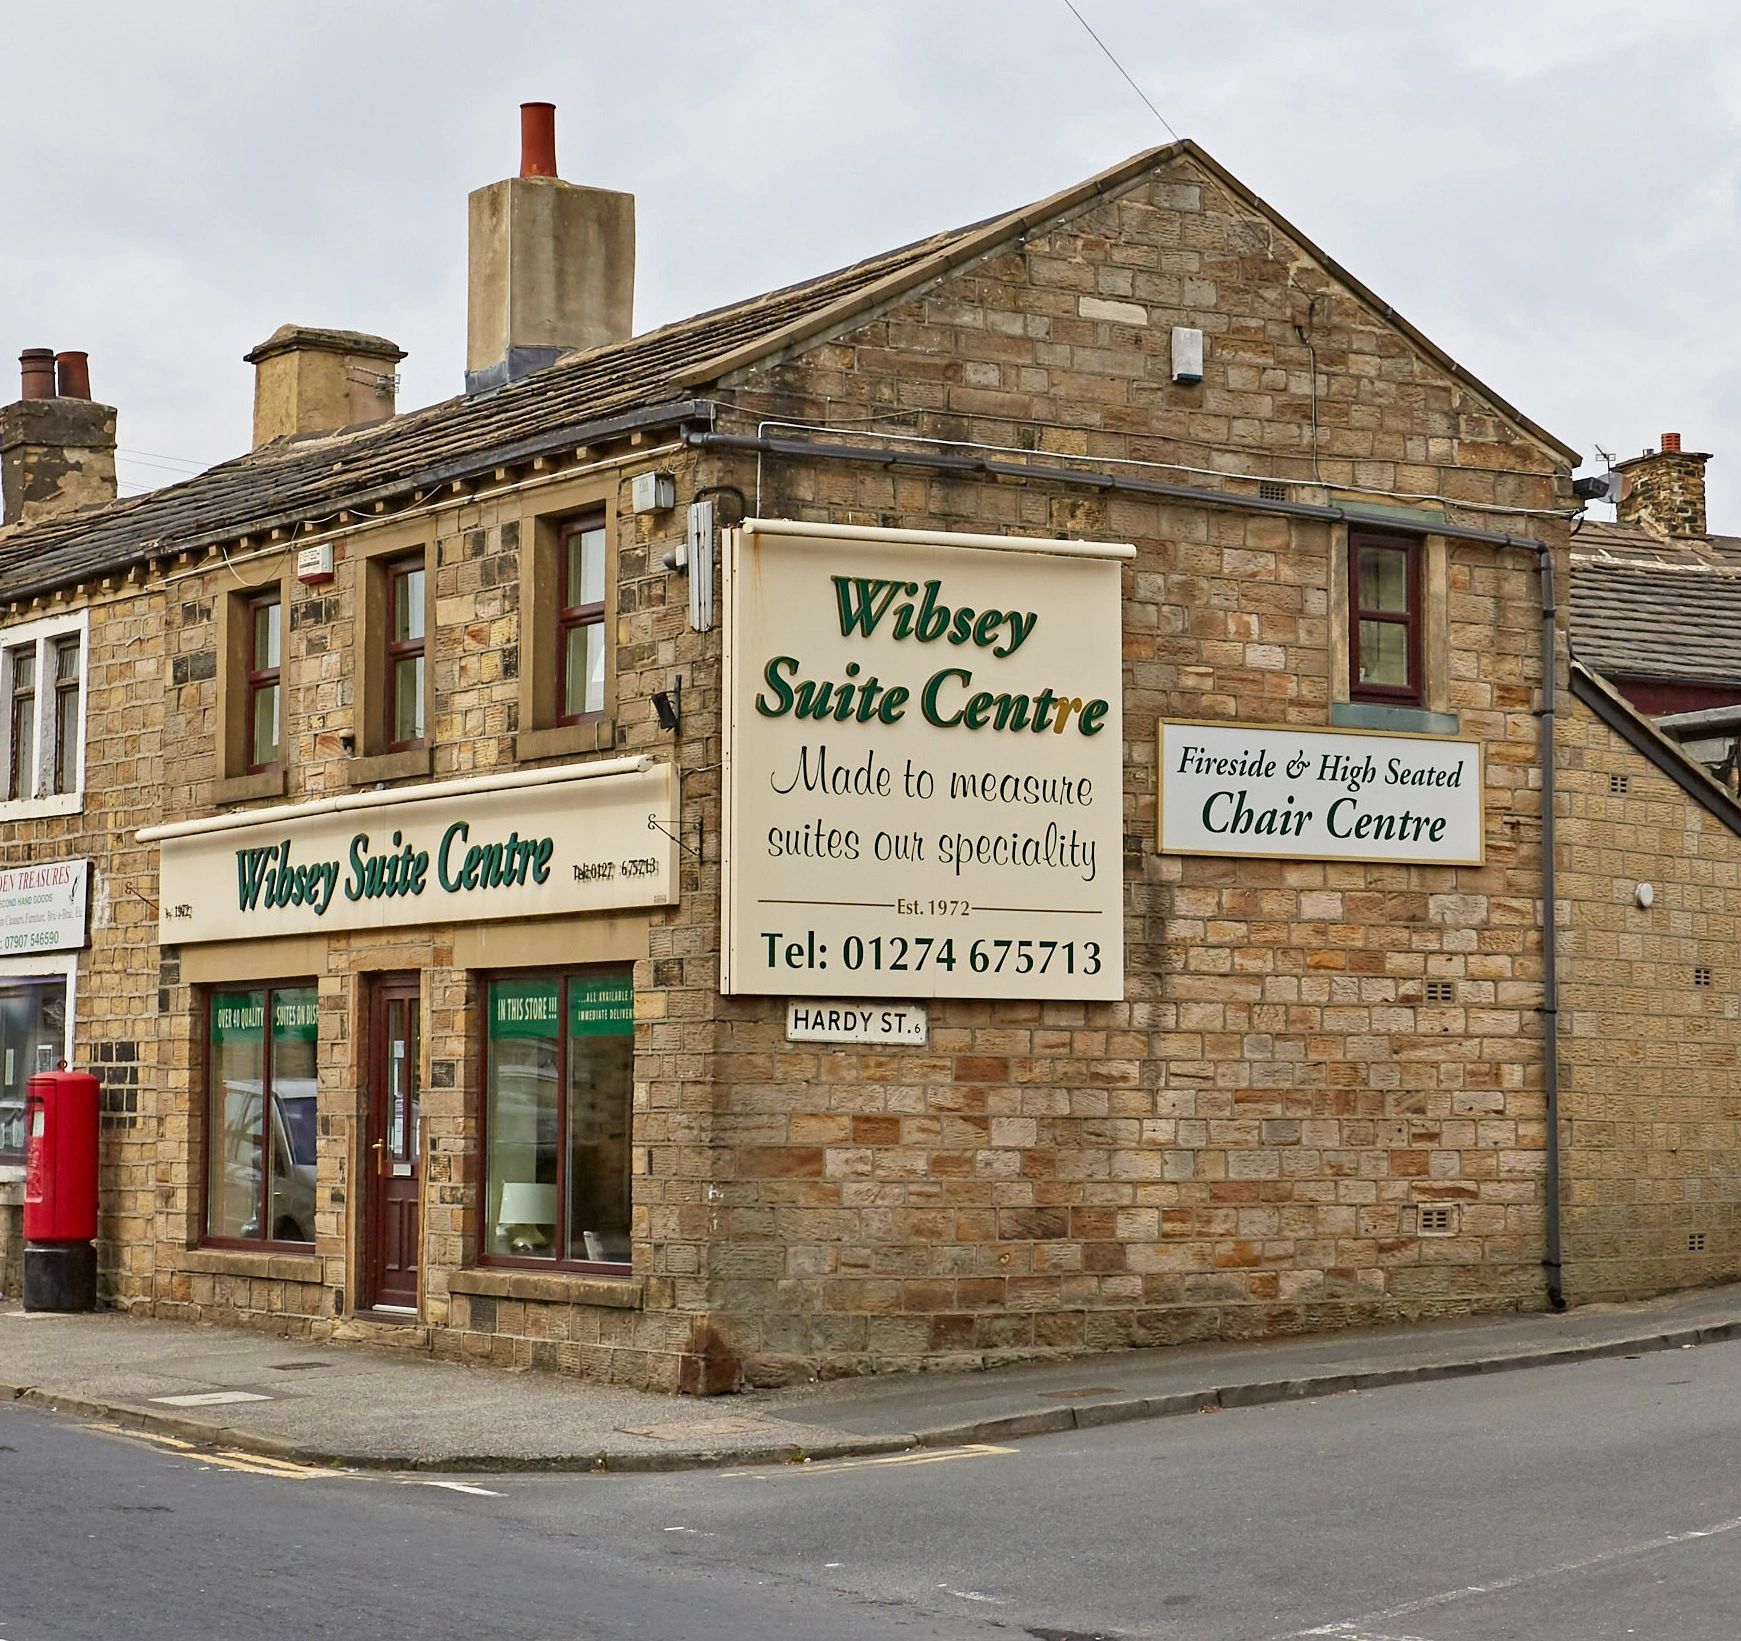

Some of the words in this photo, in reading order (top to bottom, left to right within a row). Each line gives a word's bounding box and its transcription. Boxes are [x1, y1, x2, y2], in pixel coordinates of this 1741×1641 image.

[831, 575, 1037, 658] Wibsey
[755, 655, 909, 724] Suite
[921, 667, 1109, 736] Centre
[770, 745, 891, 796] Made
[904, 760, 934, 799] to
[950, 770, 1093, 806] measure
[1177, 746, 1277, 778] Fireside
[1286, 750, 1310, 779] &
[1317, 754, 1376, 793] High
[1384, 758, 1464, 788] Seated
[1202, 790, 1312, 836] Chair
[1327, 797, 1446, 842] Centre
[767, 819, 860, 860] suites
[874, 830, 925, 862] our
[938, 821, 1096, 881] speciality
[19, 866, 71, 890] TREASURES
[235, 838, 340, 915] Wibsey
[344, 830, 429, 902] Suite
[438, 821, 554, 893] Centre
[18, 896, 32, 906] HAND
[33, 894, 53, 904] GOODS
[897, 898, 924, 915] Est.
[928, 900, 971, 917] 1972
[5, 934, 28, 949] 07907
[30, 931, 60, 947] 546590
[761, 931, 827, 970] Tel:
[843, 936, 956, 972] 01274
[970, 939, 1102, 976] 675713
[599, 990, 628, 1002] AVAILABLE
[218, 1008, 232, 1028] OVER
[233, 1008, 240, 1027] 40
[276, 1005, 296, 1026] SUITES
[296, 1005, 305, 1025] ON
[498, 998, 506, 1021] IN
[507, 998, 524, 1020] THIS
[525, 997, 547, 1020] STORE
[578, 1009, 608, 1021] IMMEDIATE
[794, 1009, 873, 1032] HARDY
[881, 1012, 911, 1033] ST.
[914, 1023, 921, 1034] 6
